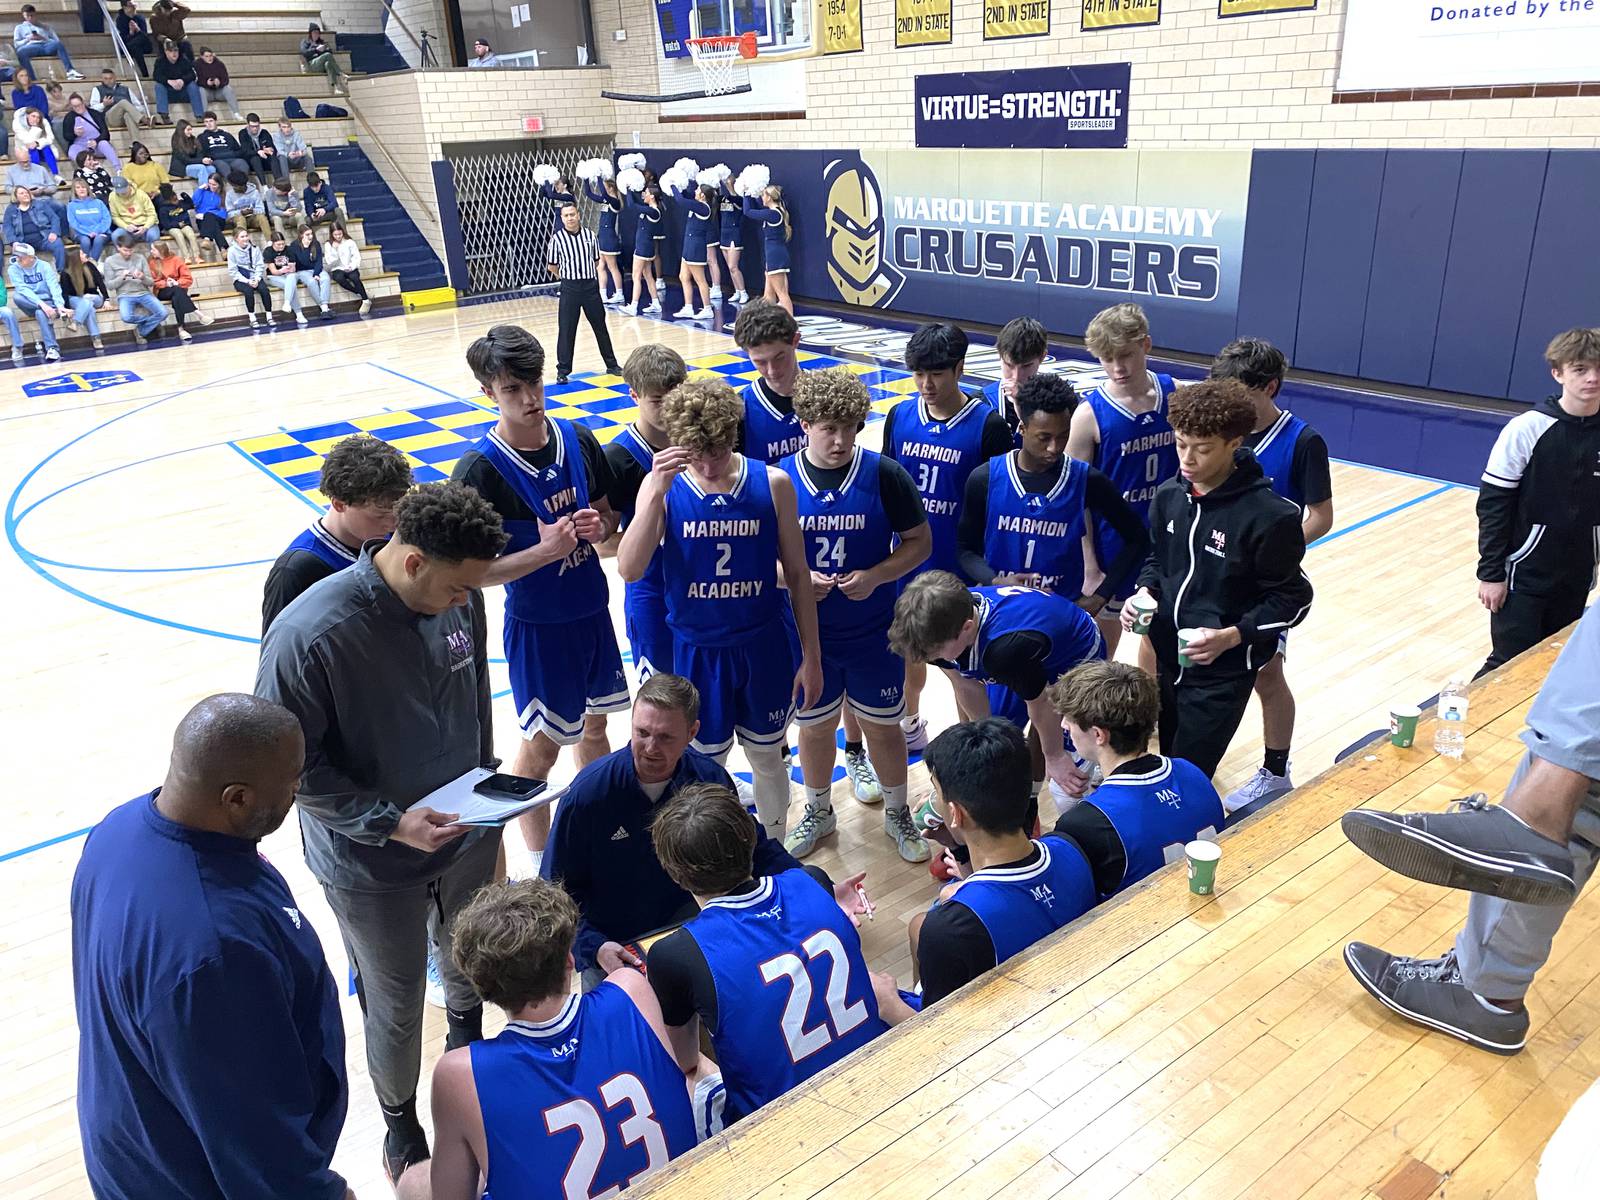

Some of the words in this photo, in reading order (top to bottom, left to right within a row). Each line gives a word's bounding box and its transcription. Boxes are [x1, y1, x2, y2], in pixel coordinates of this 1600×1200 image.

[986, 8, 1005, 24] 2ND
[1008, 6, 1018, 22] IN
[1021, 1, 1047, 21] STATE
[1430, 1, 1517, 21] Donated
[1526, 0, 1550, 18] by
[1559, 0, 1595, 12] the
[898, 17, 914, 33] 2ND
[915, 16, 923, 31] IN
[925, 13, 949, 30] STATE
[1069, 119, 1114, 129] SPORTSLEADER
[893, 196, 1051, 228] MARQUETTE
[1055, 203, 1222, 238] ACADEMY
[893, 225, 1221, 301] CRUSADERS
[767, 435, 809, 458] MARM
[902, 441, 962, 465] MARMION
[916, 463, 939, 494] 31
[1146, 453, 1158, 482] 0
[922, 497, 958, 515] DEMY
[683, 519, 761, 538] MARMION
[799, 514, 865, 531] MARMION
[997, 515, 1068, 538] MARMION
[715, 543, 732, 576] 2
[815, 536, 847, 568] 24
[1024, 540, 1036, 568] 1
[687, 580, 763, 599] ACADEMY
[759, 929, 869, 1064] 22
[541, 1071, 670, 1200] 23
